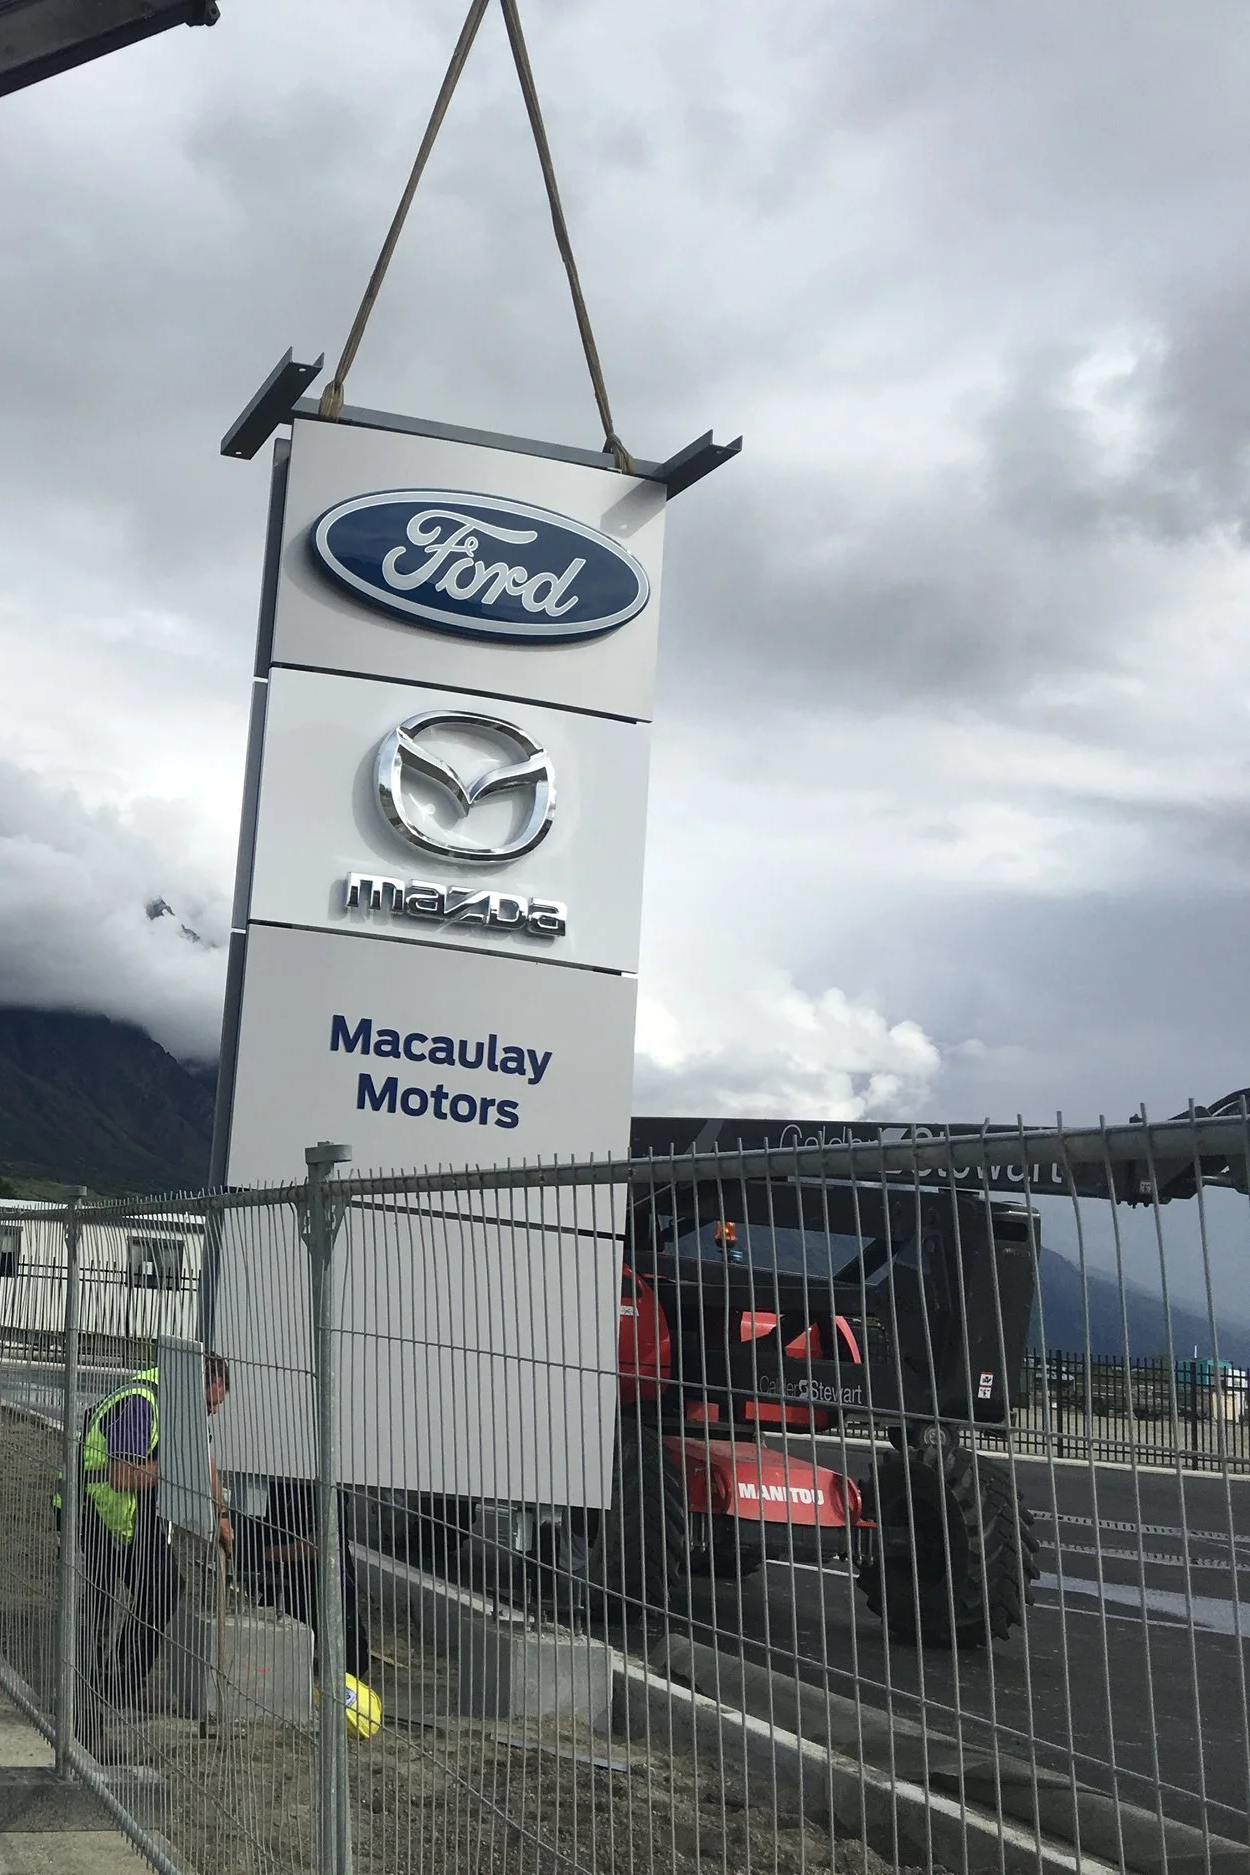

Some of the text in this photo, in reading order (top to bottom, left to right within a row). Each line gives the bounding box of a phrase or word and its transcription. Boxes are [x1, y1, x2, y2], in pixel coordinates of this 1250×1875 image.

[382, 510, 586, 617] Ford
[330, 1015, 552, 1085] Macaulay
[356, 1074, 520, 1129] Motors
